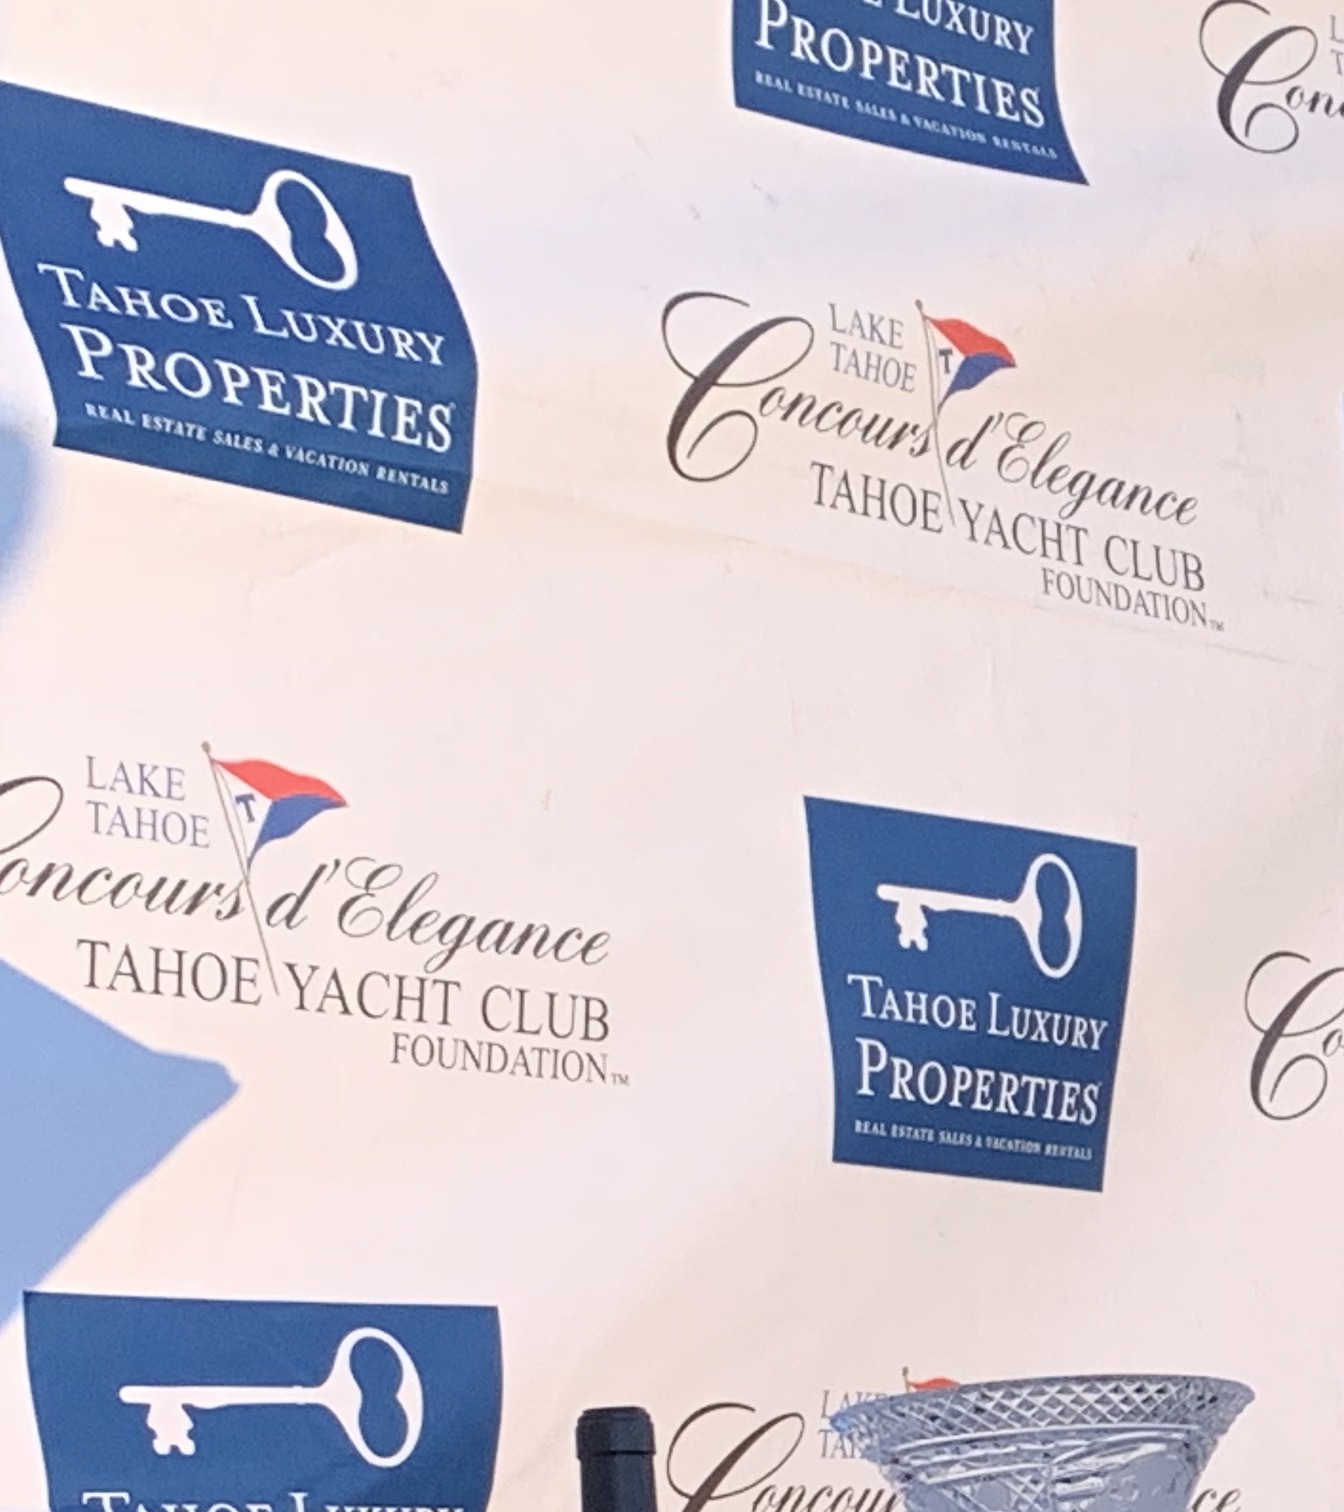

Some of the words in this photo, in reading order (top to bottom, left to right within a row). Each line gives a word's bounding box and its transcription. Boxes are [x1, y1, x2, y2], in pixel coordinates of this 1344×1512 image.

[755, 0, 1045, 128] PROPERTIES
[38, 262, 232, 331] TAHOE
[241, 294, 447, 366] LUXURY
[829, 303, 904, 349] LAKE
[60, 323, 453, 453] PROPERTIES
[662, 292, 931, 482] Concours
[830, 342, 916, 393] TAHOE
[86, 403, 134, 426] REAL
[142, 413, 206, 442] ESTATE
[213, 425, 263, 455] SALES
[285, 446, 369, 477] VACATION
[376, 465, 449, 494] RENTALS
[810, 461, 943, 534] TAHOE
[958, 498, 1087, 566] YACHT
[1105, 536, 1205, 592] CLUB
[1042, 568, 1208, 628] FOUNDATION
[84, 755, 185, 801] LAKE
[86, 800, 210, 849] TAHOE
[76, 939, 263, 1005] TAHOE
[284, 962, 461, 1026] YACHT
[481, 986, 610, 1042] CLUB
[847, 974, 977, 1032] TAHOE
[988, 992, 1108, 1051] LUXURY
[390, 1033, 610, 1084] FOUNDATION
[855, 1037, 1100, 1126] PROPERTIES
[854, 1120, 886, 1137] REAL
